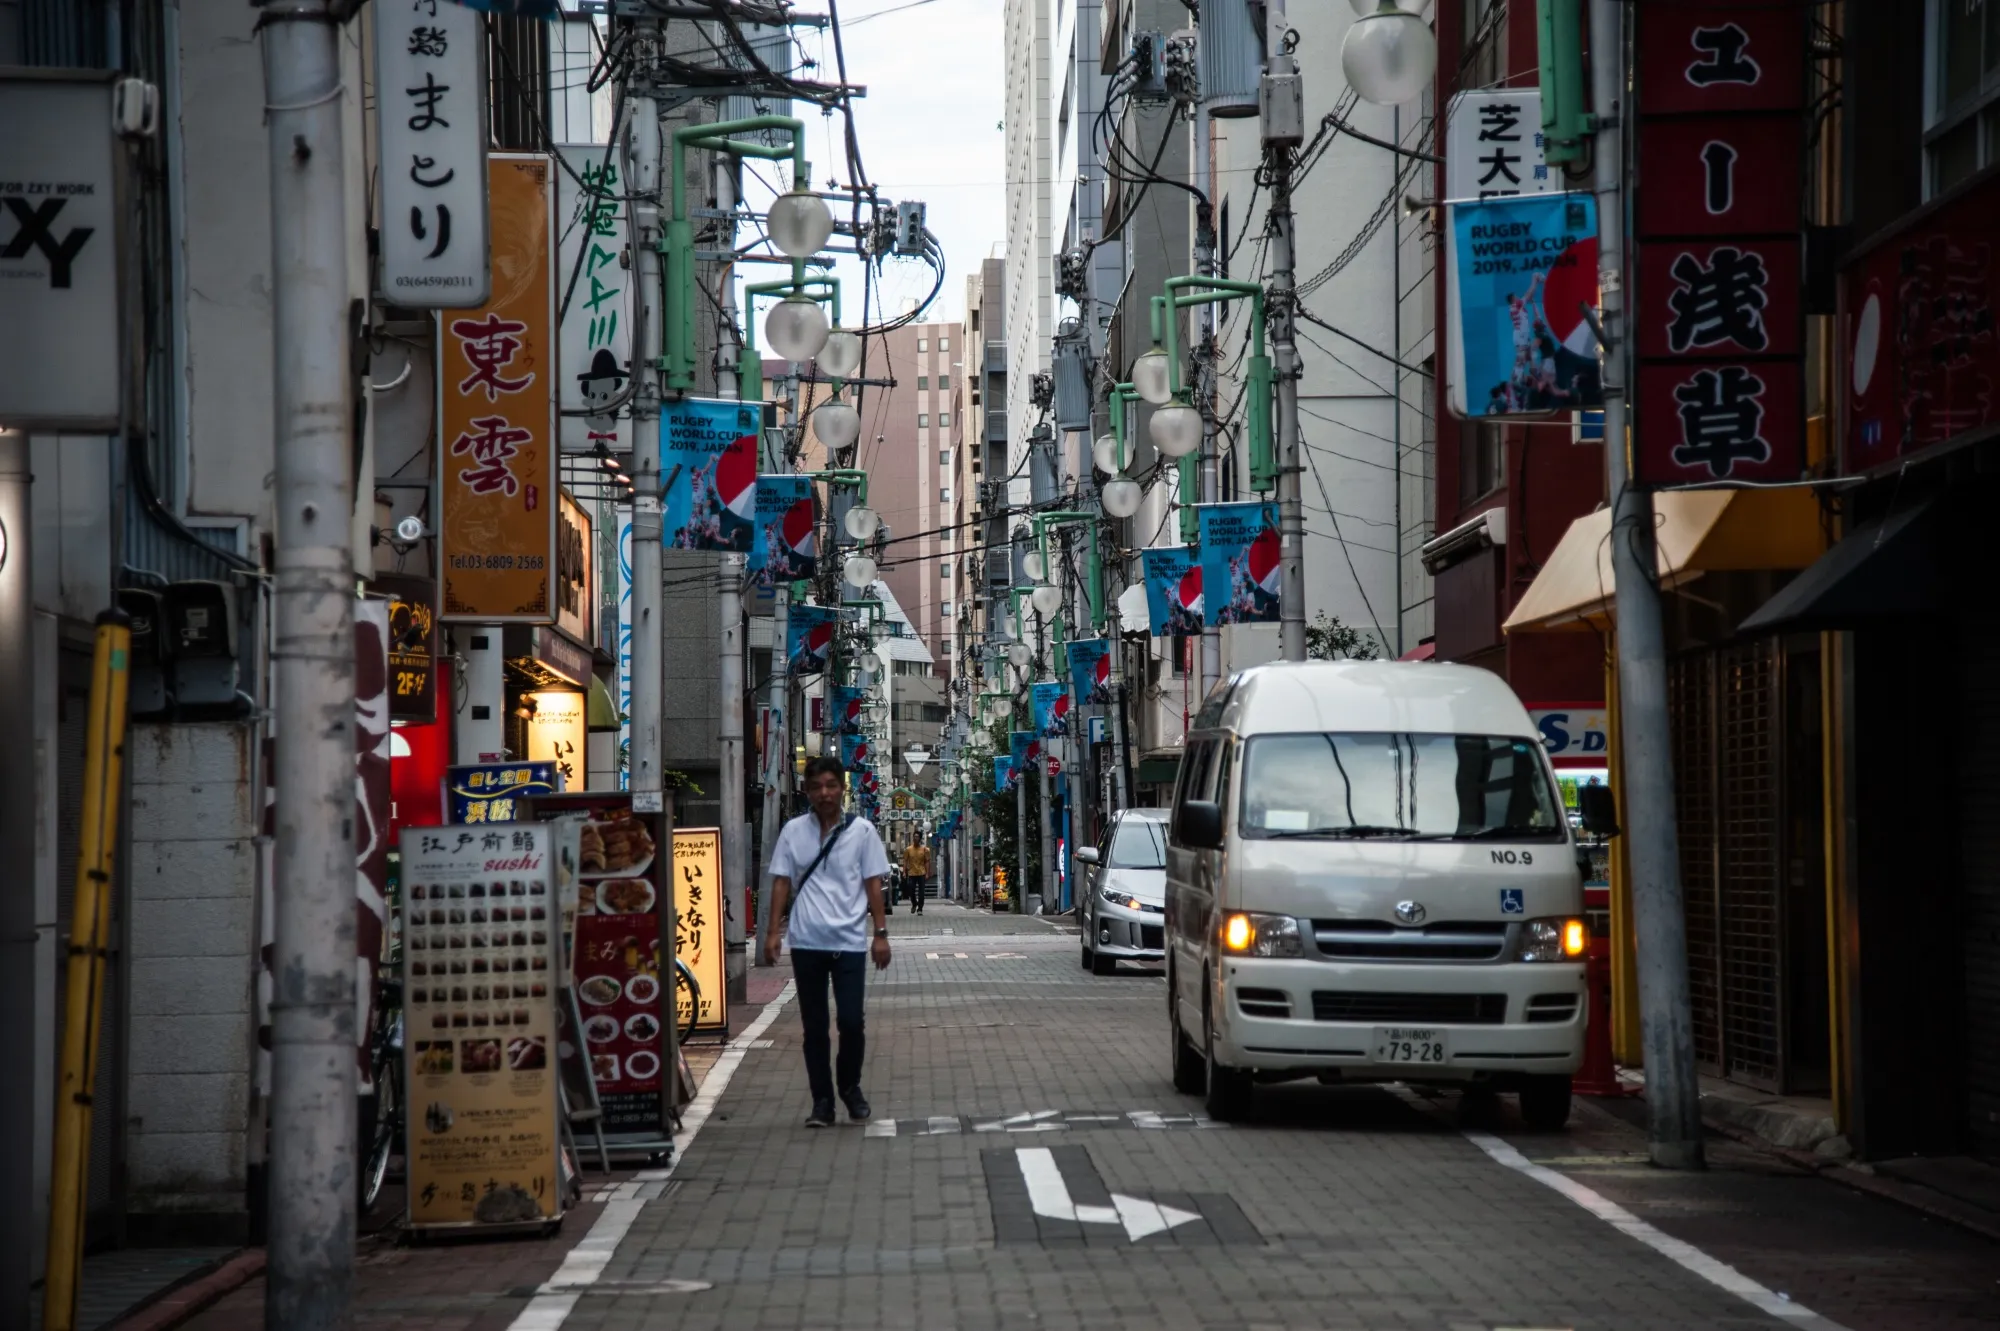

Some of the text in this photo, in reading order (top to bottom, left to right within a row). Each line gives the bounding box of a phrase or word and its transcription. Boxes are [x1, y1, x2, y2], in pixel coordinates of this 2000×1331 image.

[1478, 104, 1521, 199] 芝大
[56, 183, 95, 195] WORK
[1471, 222, 1532, 239] RUGBY
[1472, 236, 1577, 257] WORLD CUP
[1473, 253, 1578, 275] 2019, JAPAN
[396, 276, 474, 288] 03(6459)0311
[450, 311, 536, 497] 東雲
[669, 415, 713, 427] RUGBY
[669, 428, 744, 441] WORLD CUP
[669, 440, 743, 453] 2019, JAPAN
[756, 496, 780, 505] ORLD
[1208, 516, 1243, 526] RUGBY
[1208, 525, 1268, 536] WORLD CUP
[1236, 536, 1269, 545] JAPAN
[463, 798, 516, 824] 浜松
[421, 831, 535, 854] 江戸前鮨
[484, 852, 543, 872] sushi
[1490, 850, 1533, 866] NO.9
[683, 864, 706, 950] いきなり
[1389, 1042, 1443, 1061] 79-28
